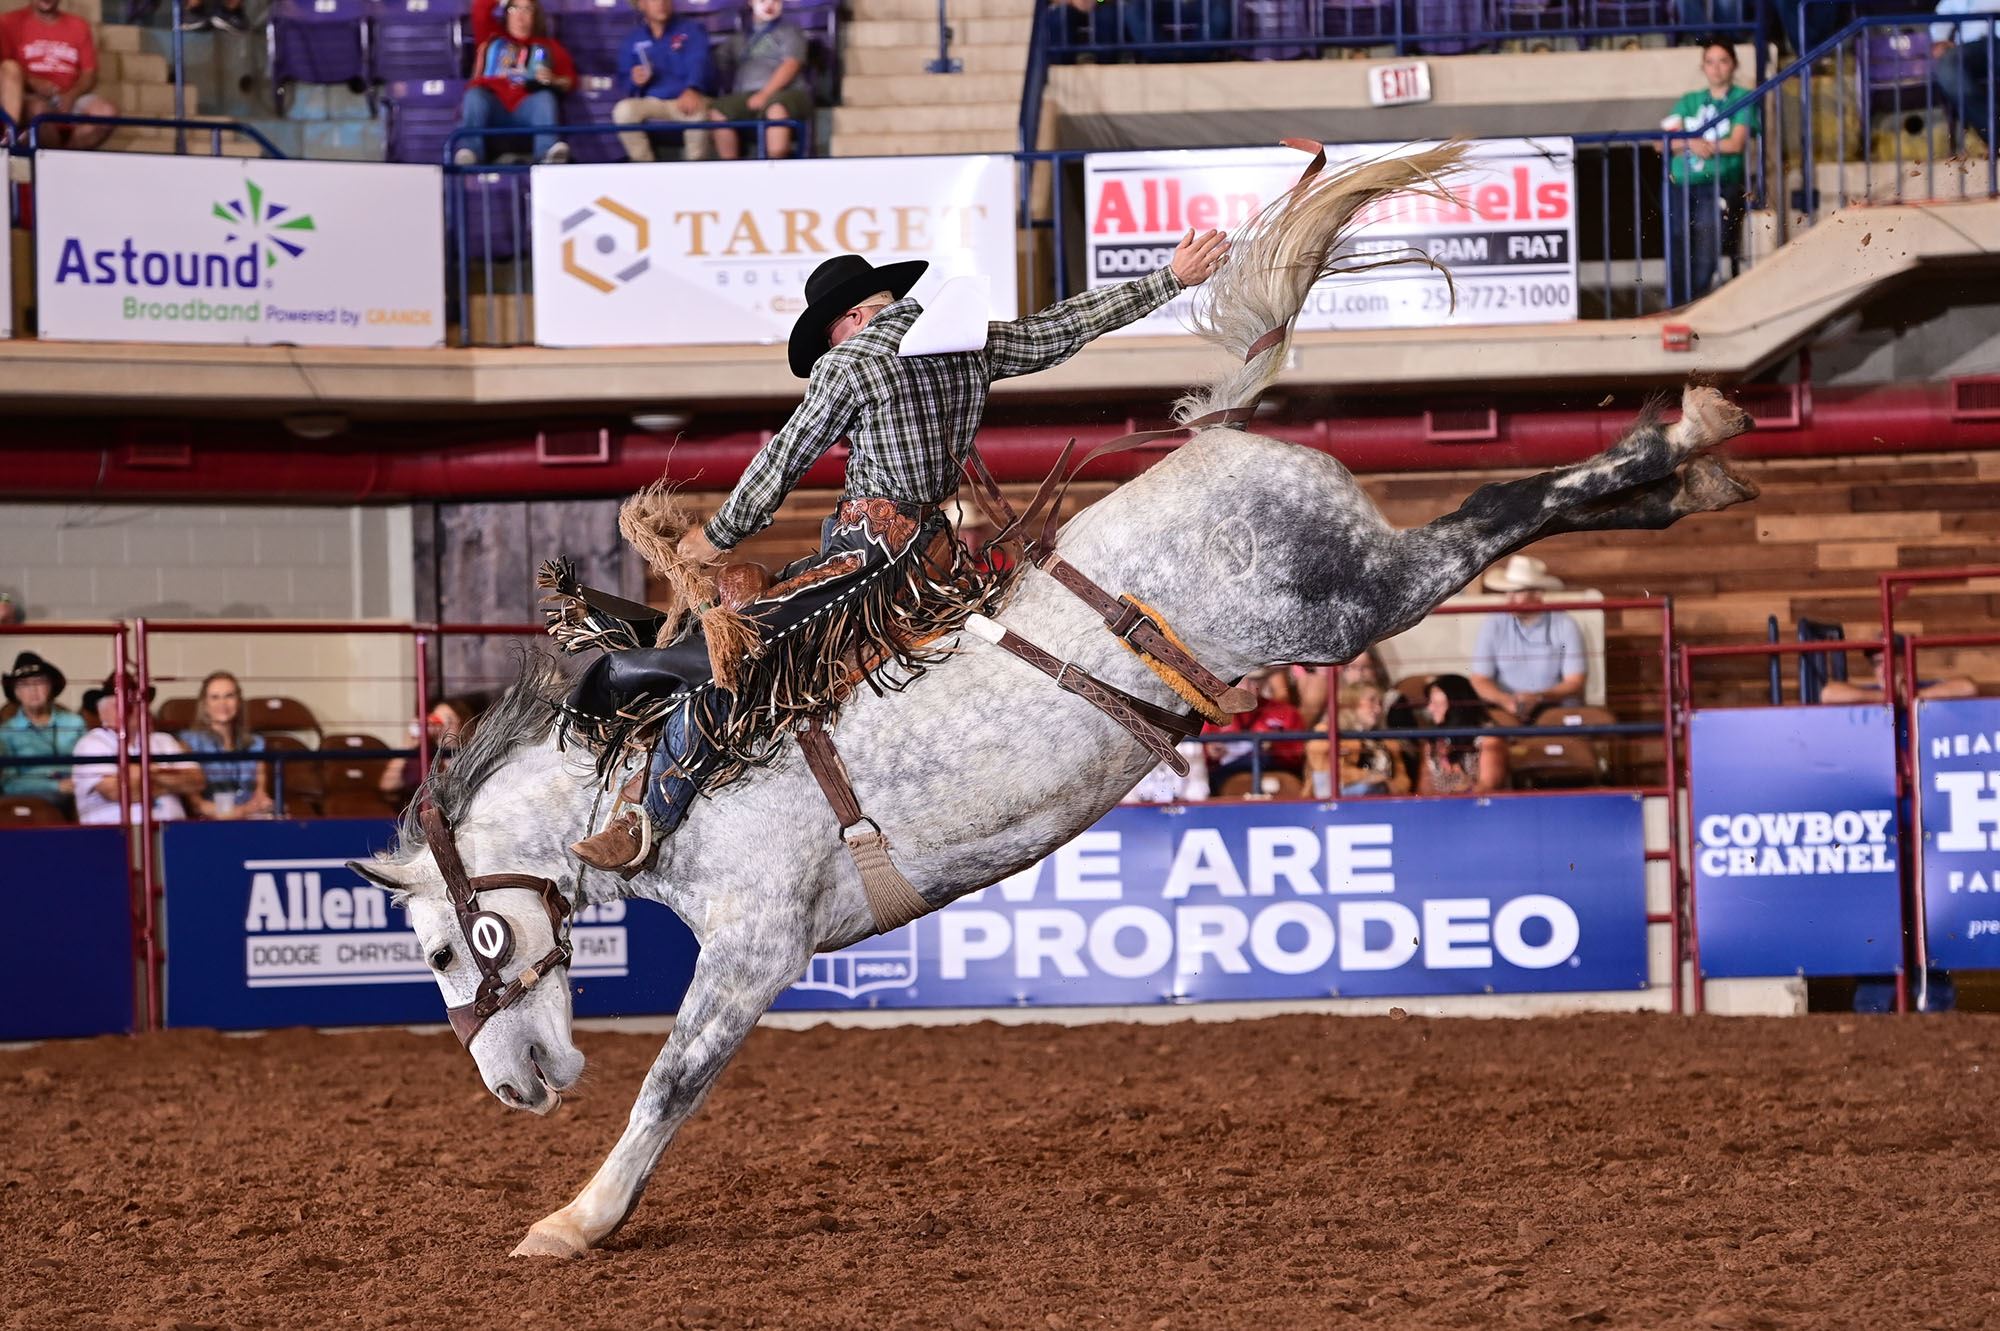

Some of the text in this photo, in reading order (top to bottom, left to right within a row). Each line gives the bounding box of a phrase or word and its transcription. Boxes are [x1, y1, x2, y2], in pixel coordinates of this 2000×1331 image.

[1381, 66, 1418, 99] EXIT
[1094, 178, 1262, 234] Allen
[675, 206, 988, 257] TARGET
[1431, 236, 1489, 261] RAM
[1508, 233, 1564, 259] FIAT
[56, 238, 259, 288] Astound
[123, 296, 260, 321] Broadband
[266, 305, 336, 324] Powered
[340, 307, 360, 327] by
[1700, 810, 1892, 848] COWBOY
[1161, 824, 1396, 899] ARE
[1700, 844, 1896, 877] CHANNEL
[246, 872, 388, 932] Allen
[254, 937, 618, 966] DODGE CHRYSLE FIAT
[939, 894, 1580, 980] PRORODEO
[857, 962, 907, 978] PRCA
